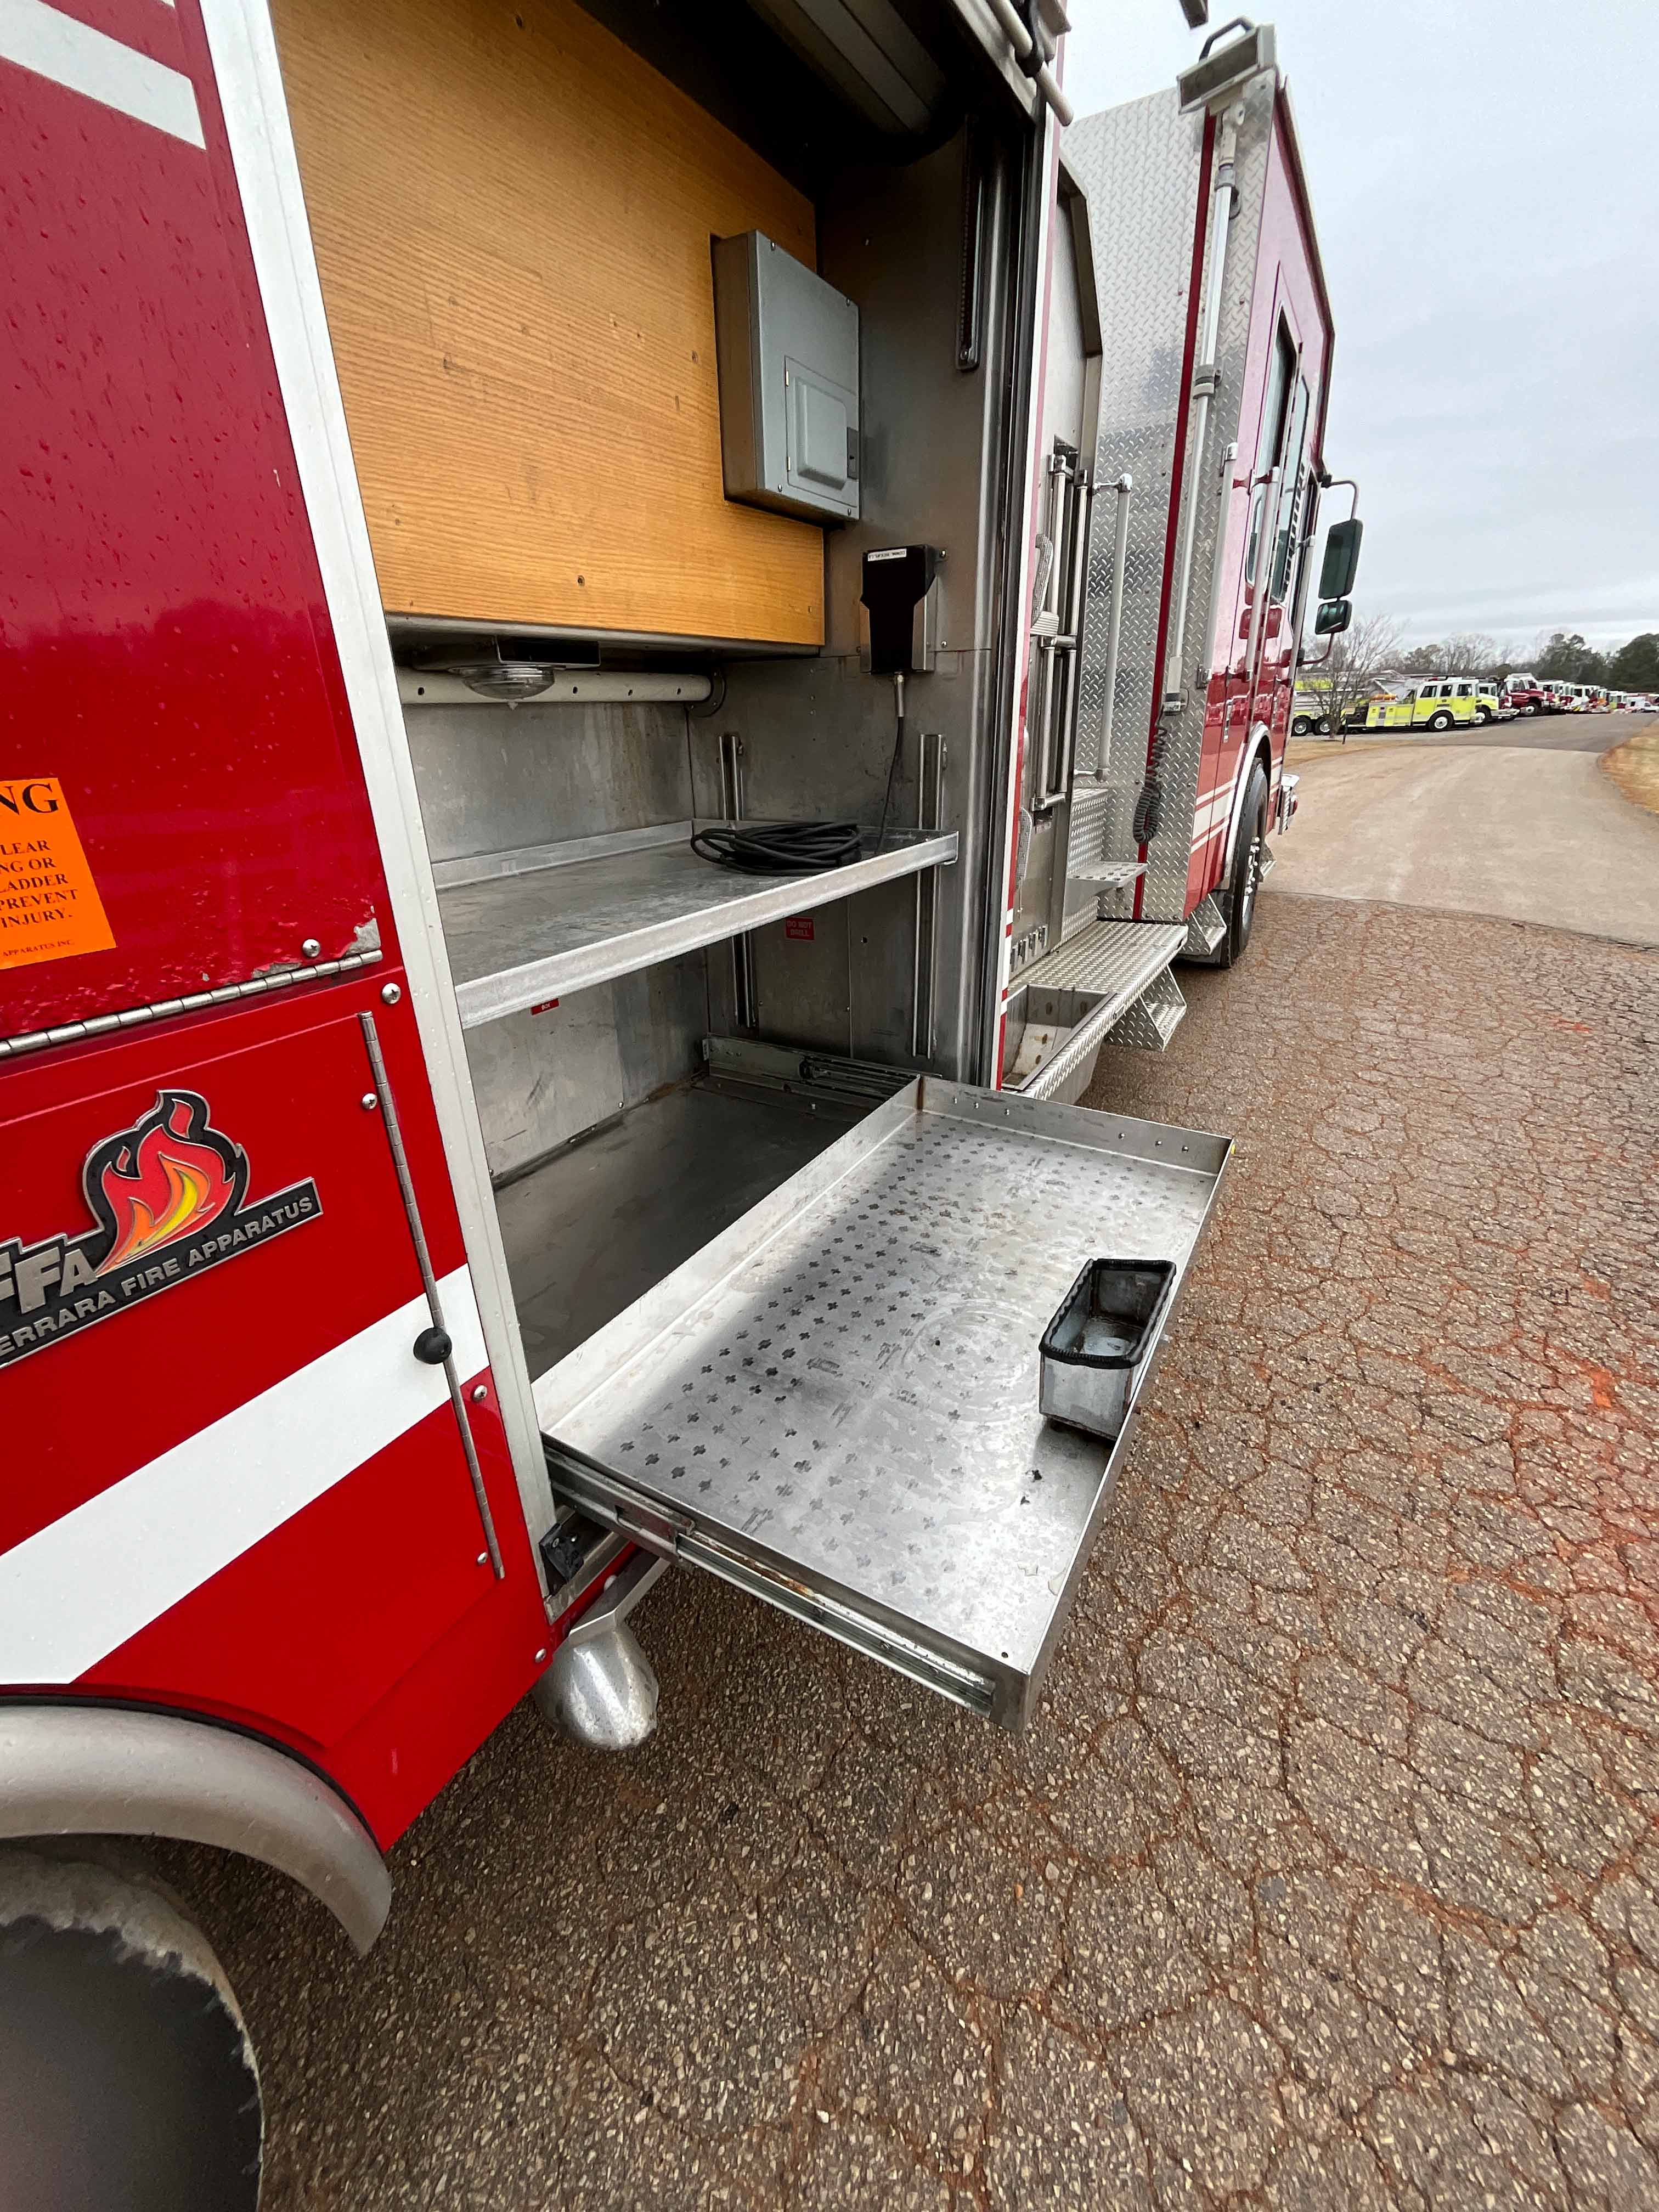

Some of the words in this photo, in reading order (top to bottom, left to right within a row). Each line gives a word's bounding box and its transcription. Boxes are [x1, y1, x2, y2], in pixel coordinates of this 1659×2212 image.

[29, 857, 57, 870] OR
[1, 907, 73, 928] INJURY.
[121, 1258, 180, 1296] FIRE
[188, 1197, 313, 1267] APPARATUS
